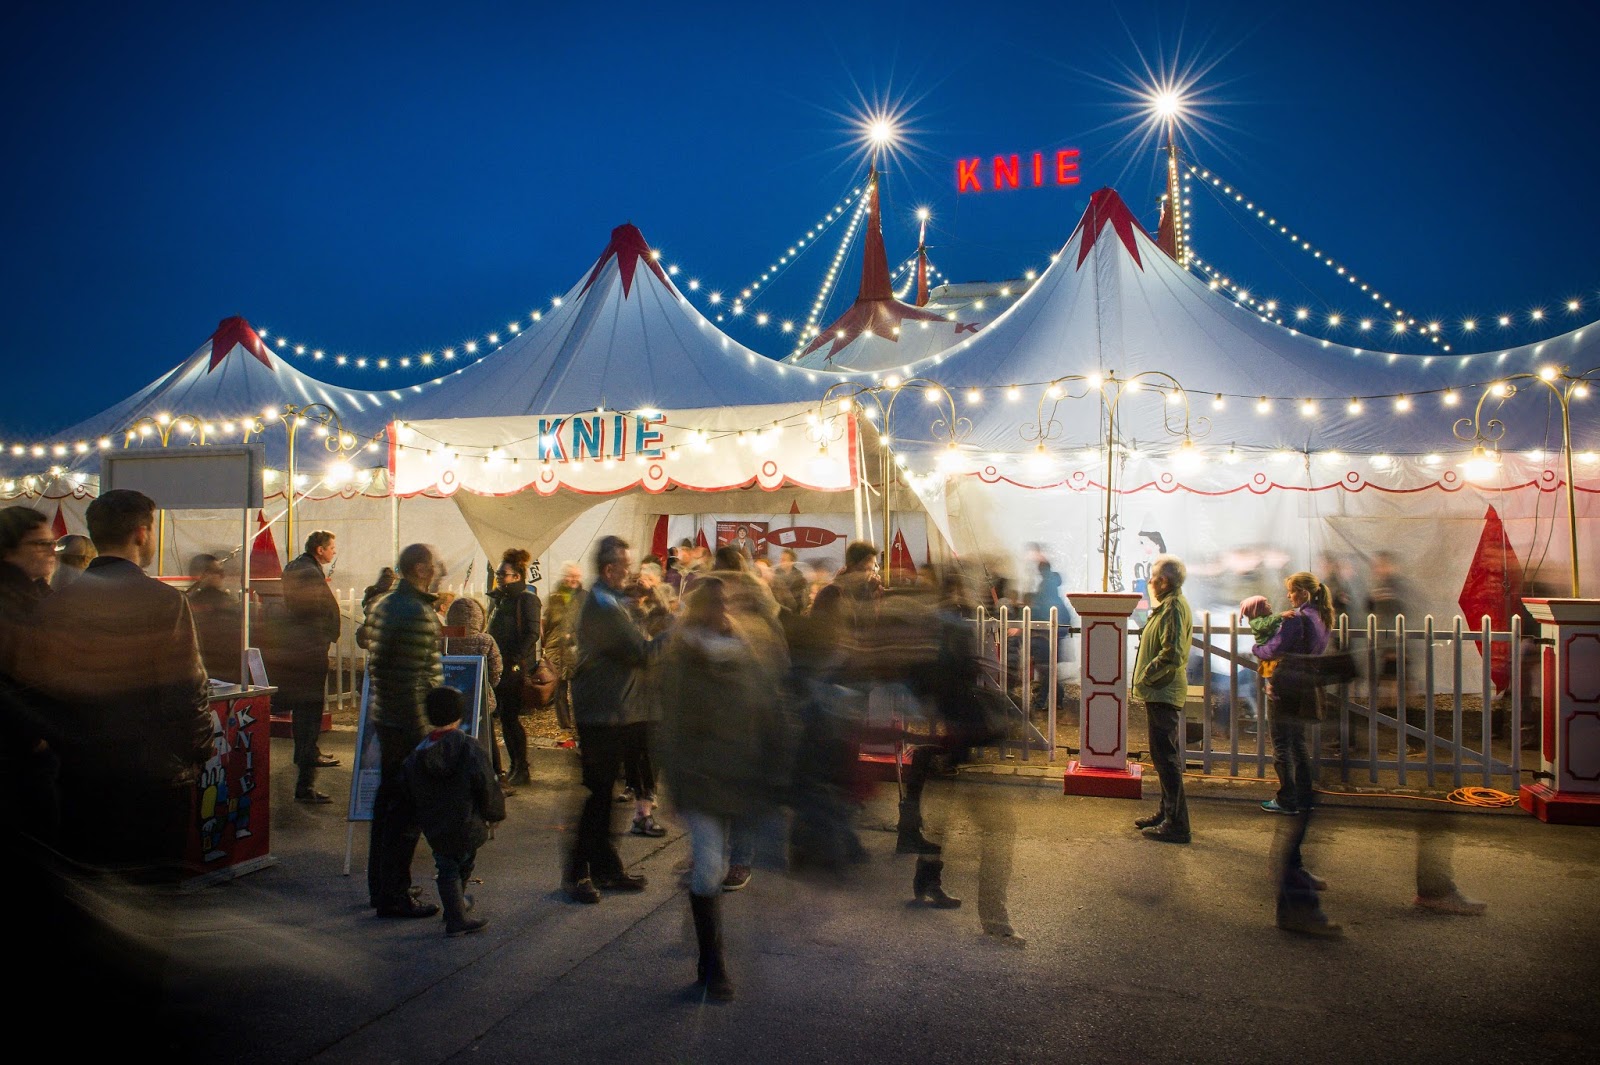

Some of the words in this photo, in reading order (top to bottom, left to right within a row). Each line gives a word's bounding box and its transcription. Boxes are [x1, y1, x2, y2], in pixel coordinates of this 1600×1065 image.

[958, 150, 1080, 192] KNIE
[538, 413, 667, 463] KNIE
[234, 704, 257, 794] KNIE
